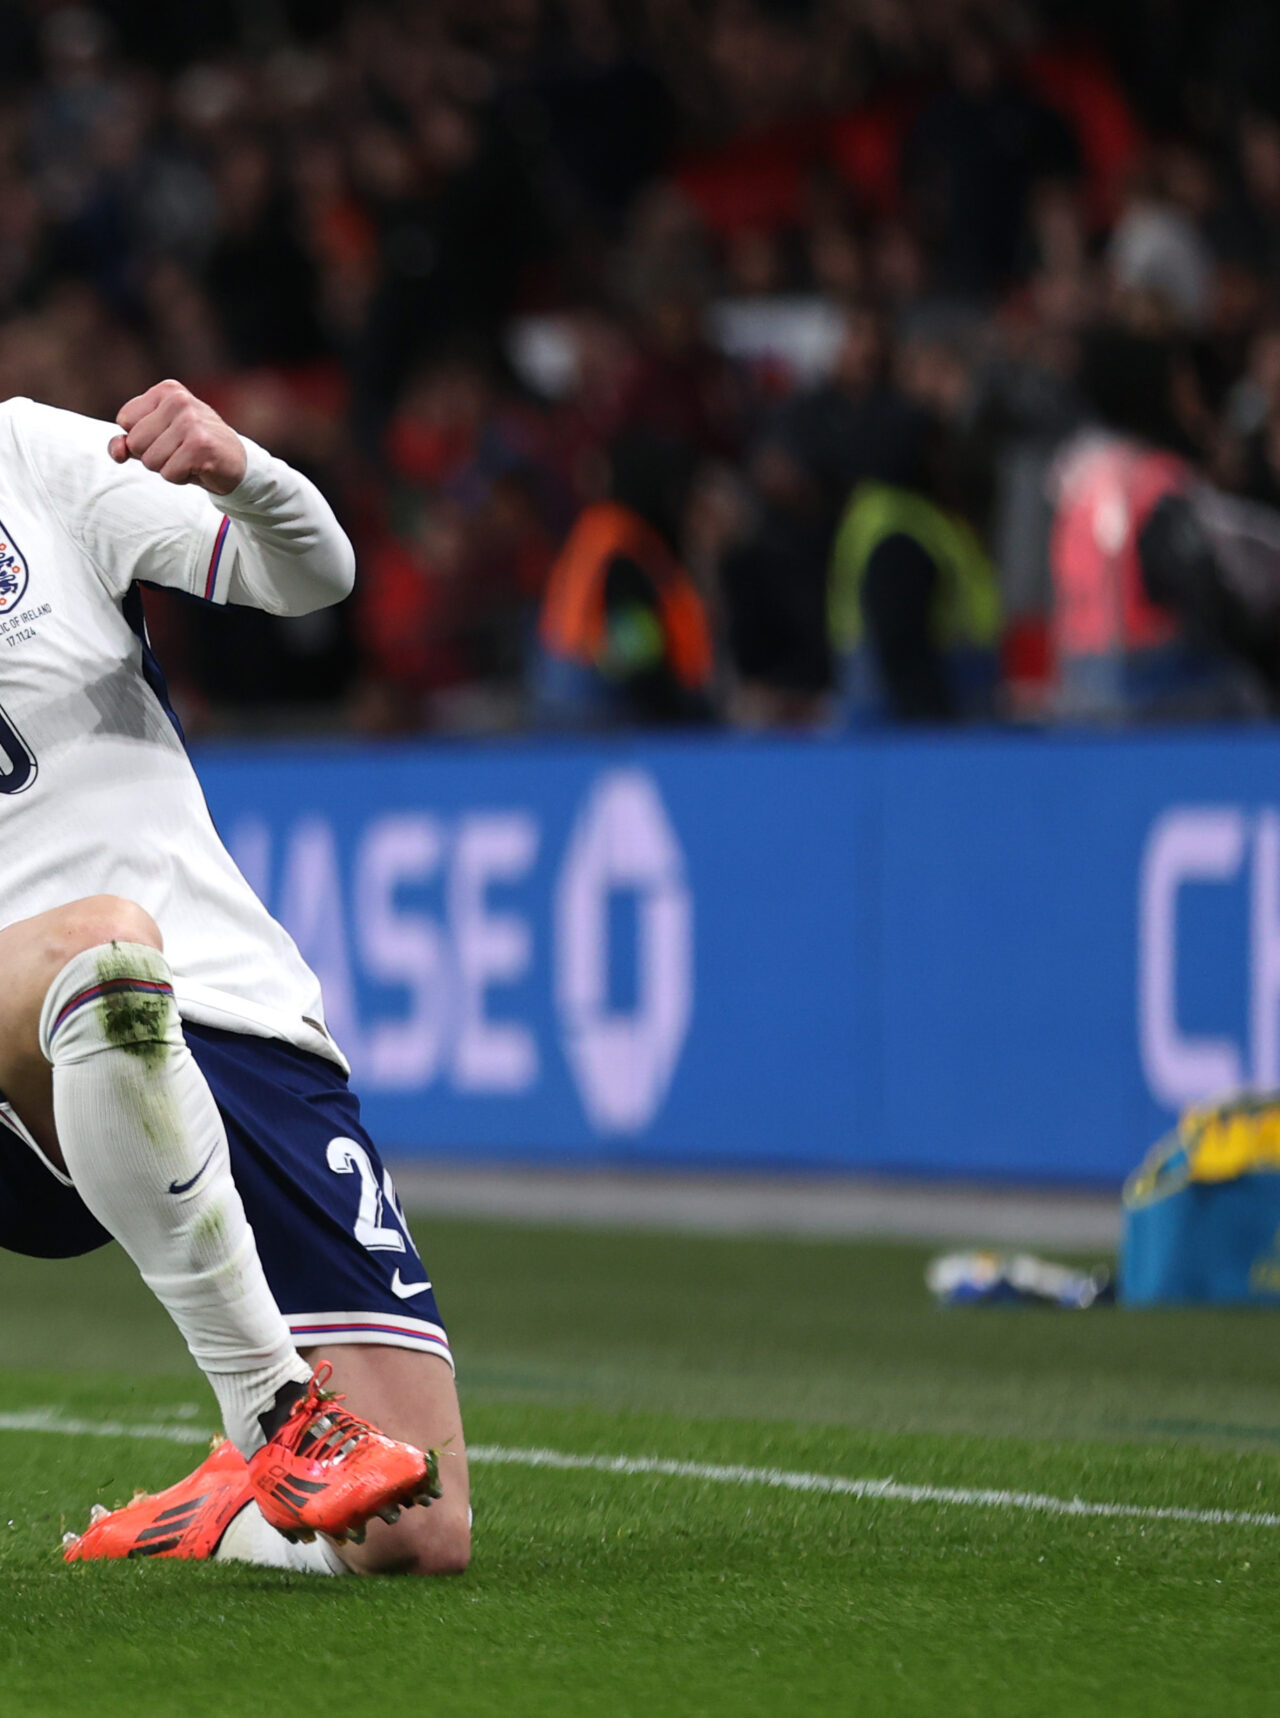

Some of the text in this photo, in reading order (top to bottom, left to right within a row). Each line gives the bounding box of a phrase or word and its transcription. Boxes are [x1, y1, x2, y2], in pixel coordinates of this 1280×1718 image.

[9, 616, 20, 629] OF
[20, 603, 52, 623] IRELAND
[6, 627, 36, 647] 17.11.24
[230, 812, 540, 1095] ASE
